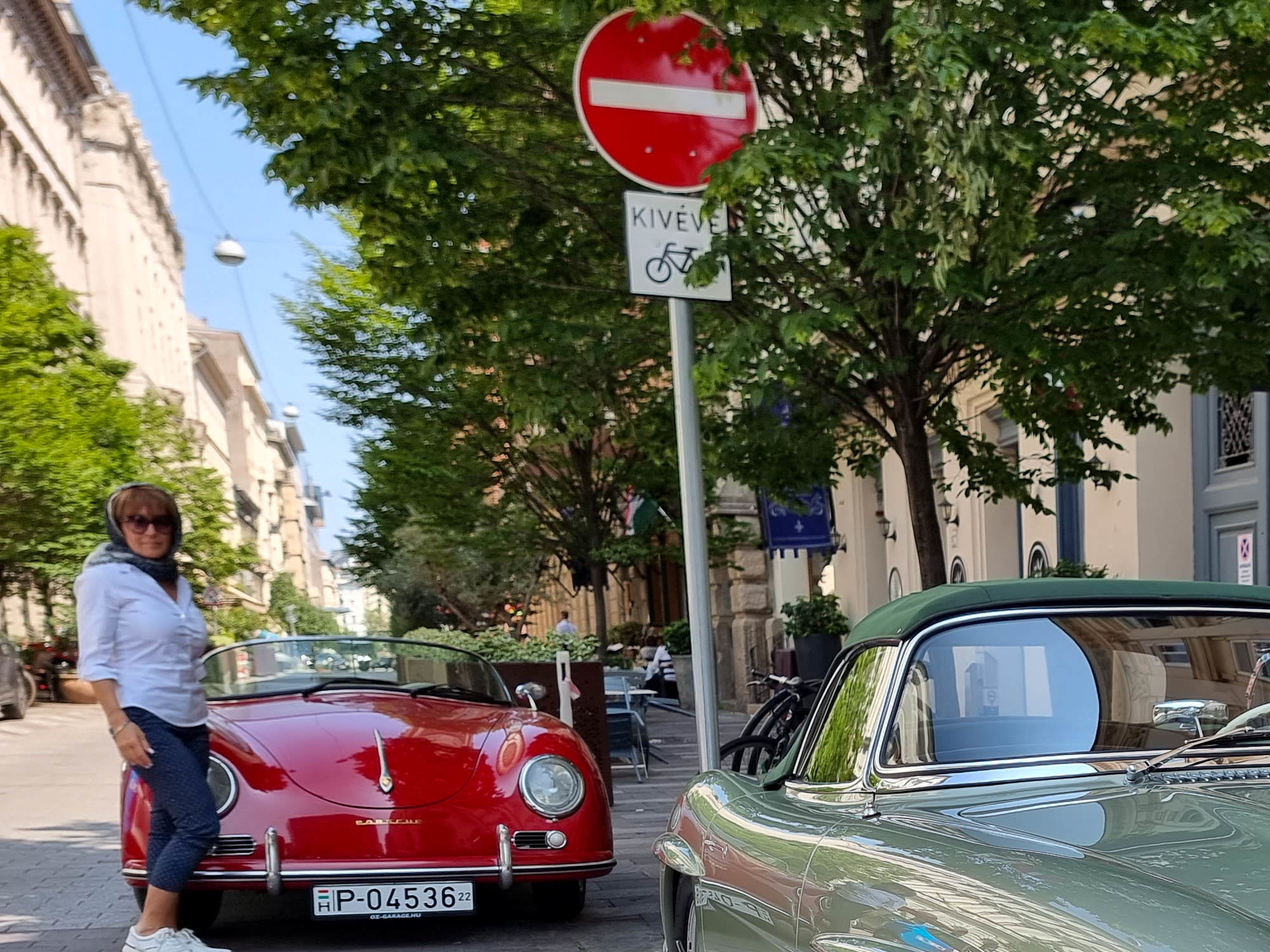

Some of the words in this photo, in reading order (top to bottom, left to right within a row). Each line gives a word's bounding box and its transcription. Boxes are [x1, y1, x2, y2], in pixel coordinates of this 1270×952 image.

[318, 901, 331, 913] H
[336, 886, 456, 912] P-04536
[457, 892, 472, 902] 22
